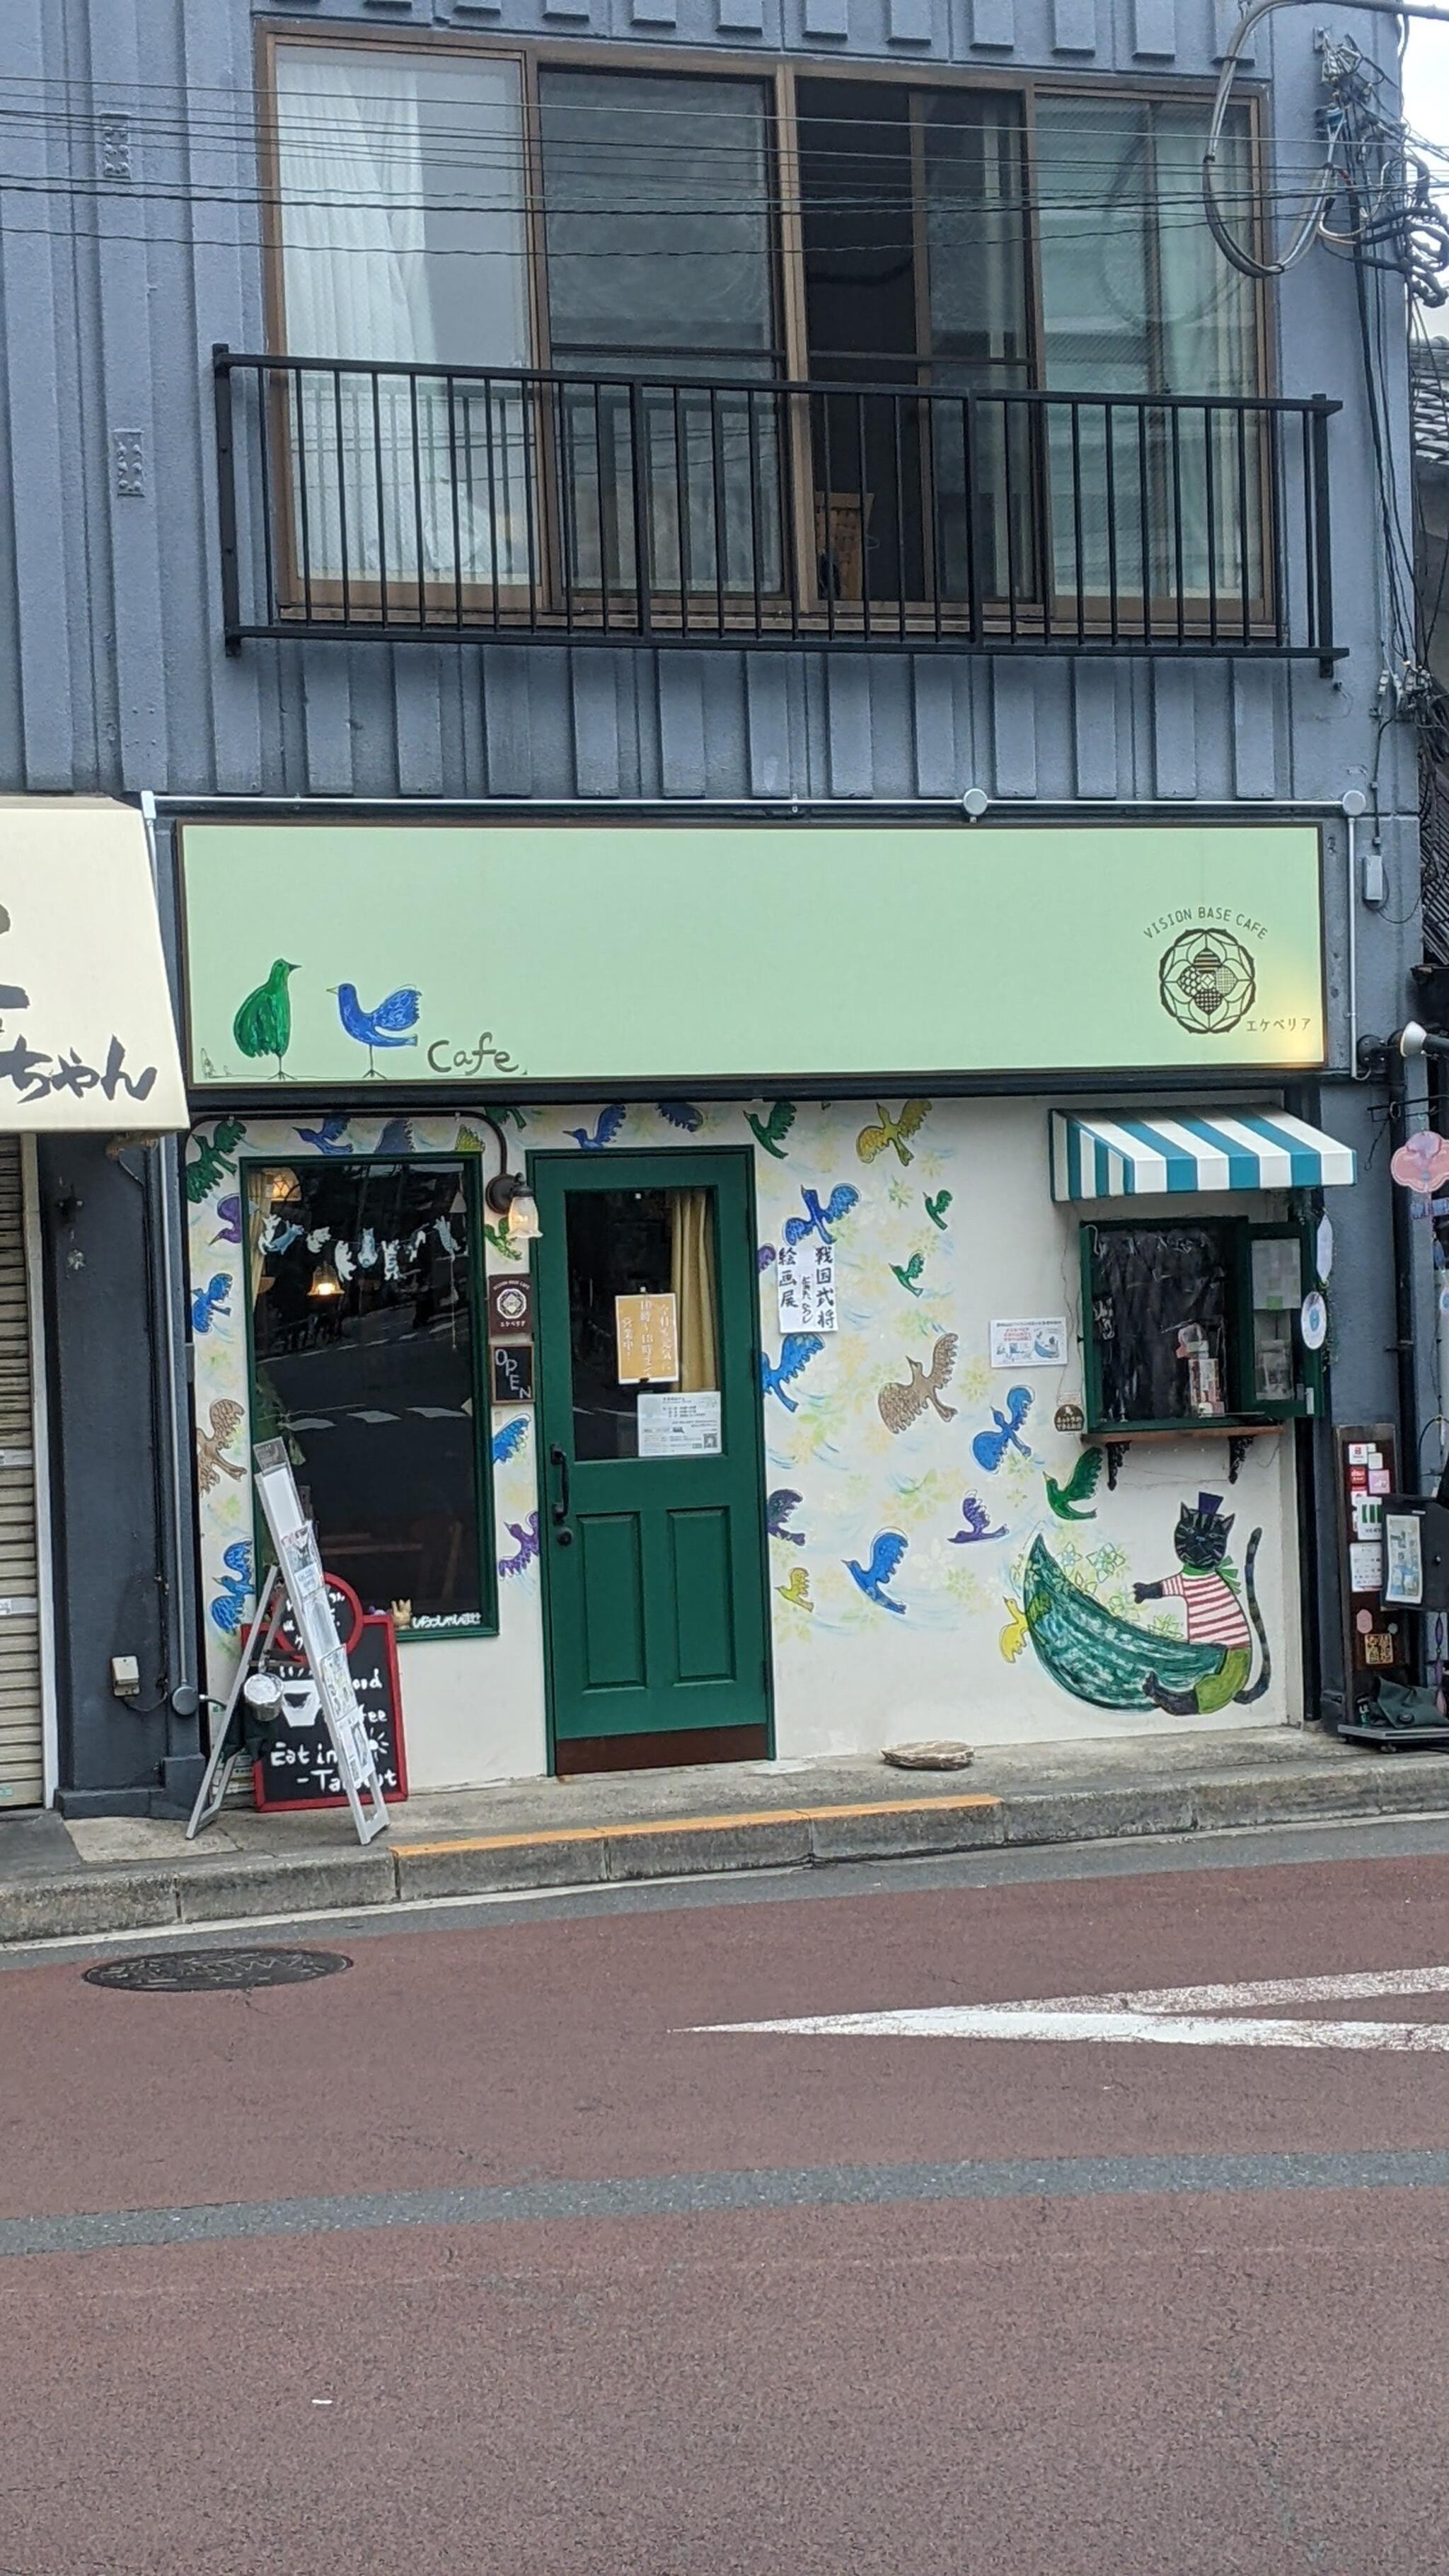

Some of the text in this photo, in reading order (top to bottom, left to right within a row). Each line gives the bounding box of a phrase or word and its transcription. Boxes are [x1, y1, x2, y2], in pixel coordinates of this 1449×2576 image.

[1143, 906, 1268, 940] VISION BASE CAFE
[1246, 1017, 1311, 1032] エケベリア
[427, 1032, 519, 1075] Cafe
[495, 1348, 532, 1399] OPEN
[270, 1741, 337, 1767] Eat in
